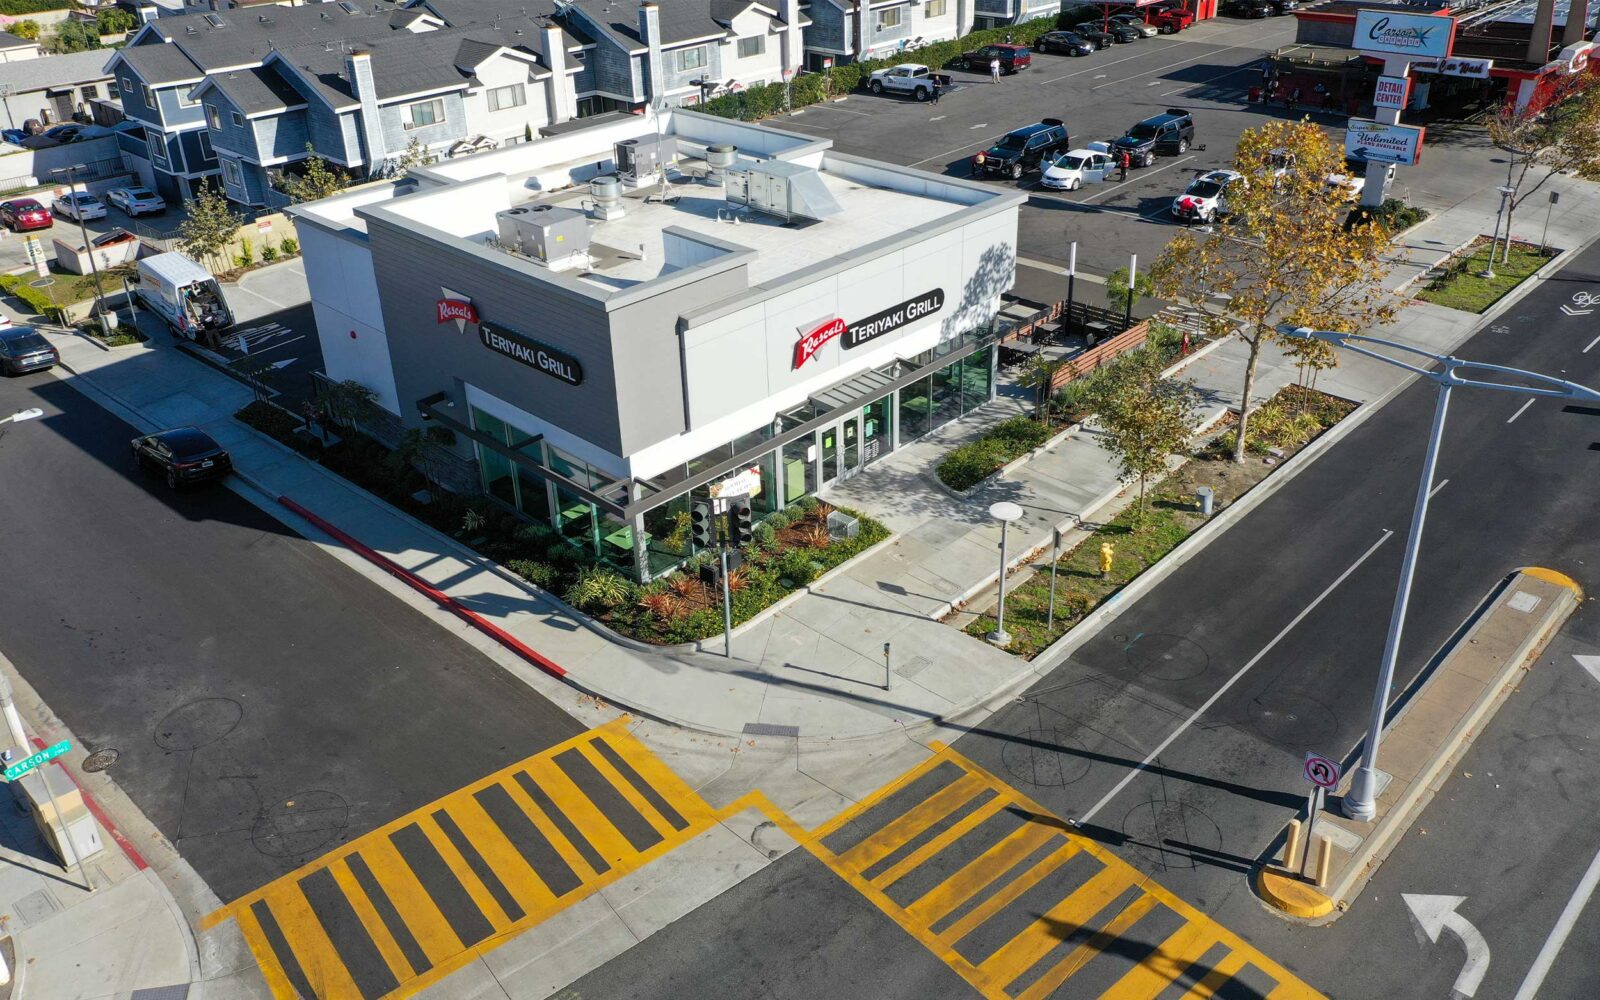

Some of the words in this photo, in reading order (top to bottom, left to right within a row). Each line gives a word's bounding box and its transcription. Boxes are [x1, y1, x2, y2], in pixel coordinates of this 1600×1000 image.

[1369, 17, 1412, 40] Carson
[1378, 81, 1404, 95] DETAIL
[1375, 92, 1402, 105] CENTER
[1357, 132, 1409, 146] Unlimited
[1376, 143, 1407, 152] AVAILABLE
[438, 302, 472, 320] Rascals
[849, 310, 905, 344] TERIYAKI
[906, 296, 941, 319] GRILL
[801, 320, 844, 360] Rascals
[481, 325, 536, 365] TERIYAKI
[537, 350, 577, 383] GRILL
[6, 751, 50, 778] CARSON
